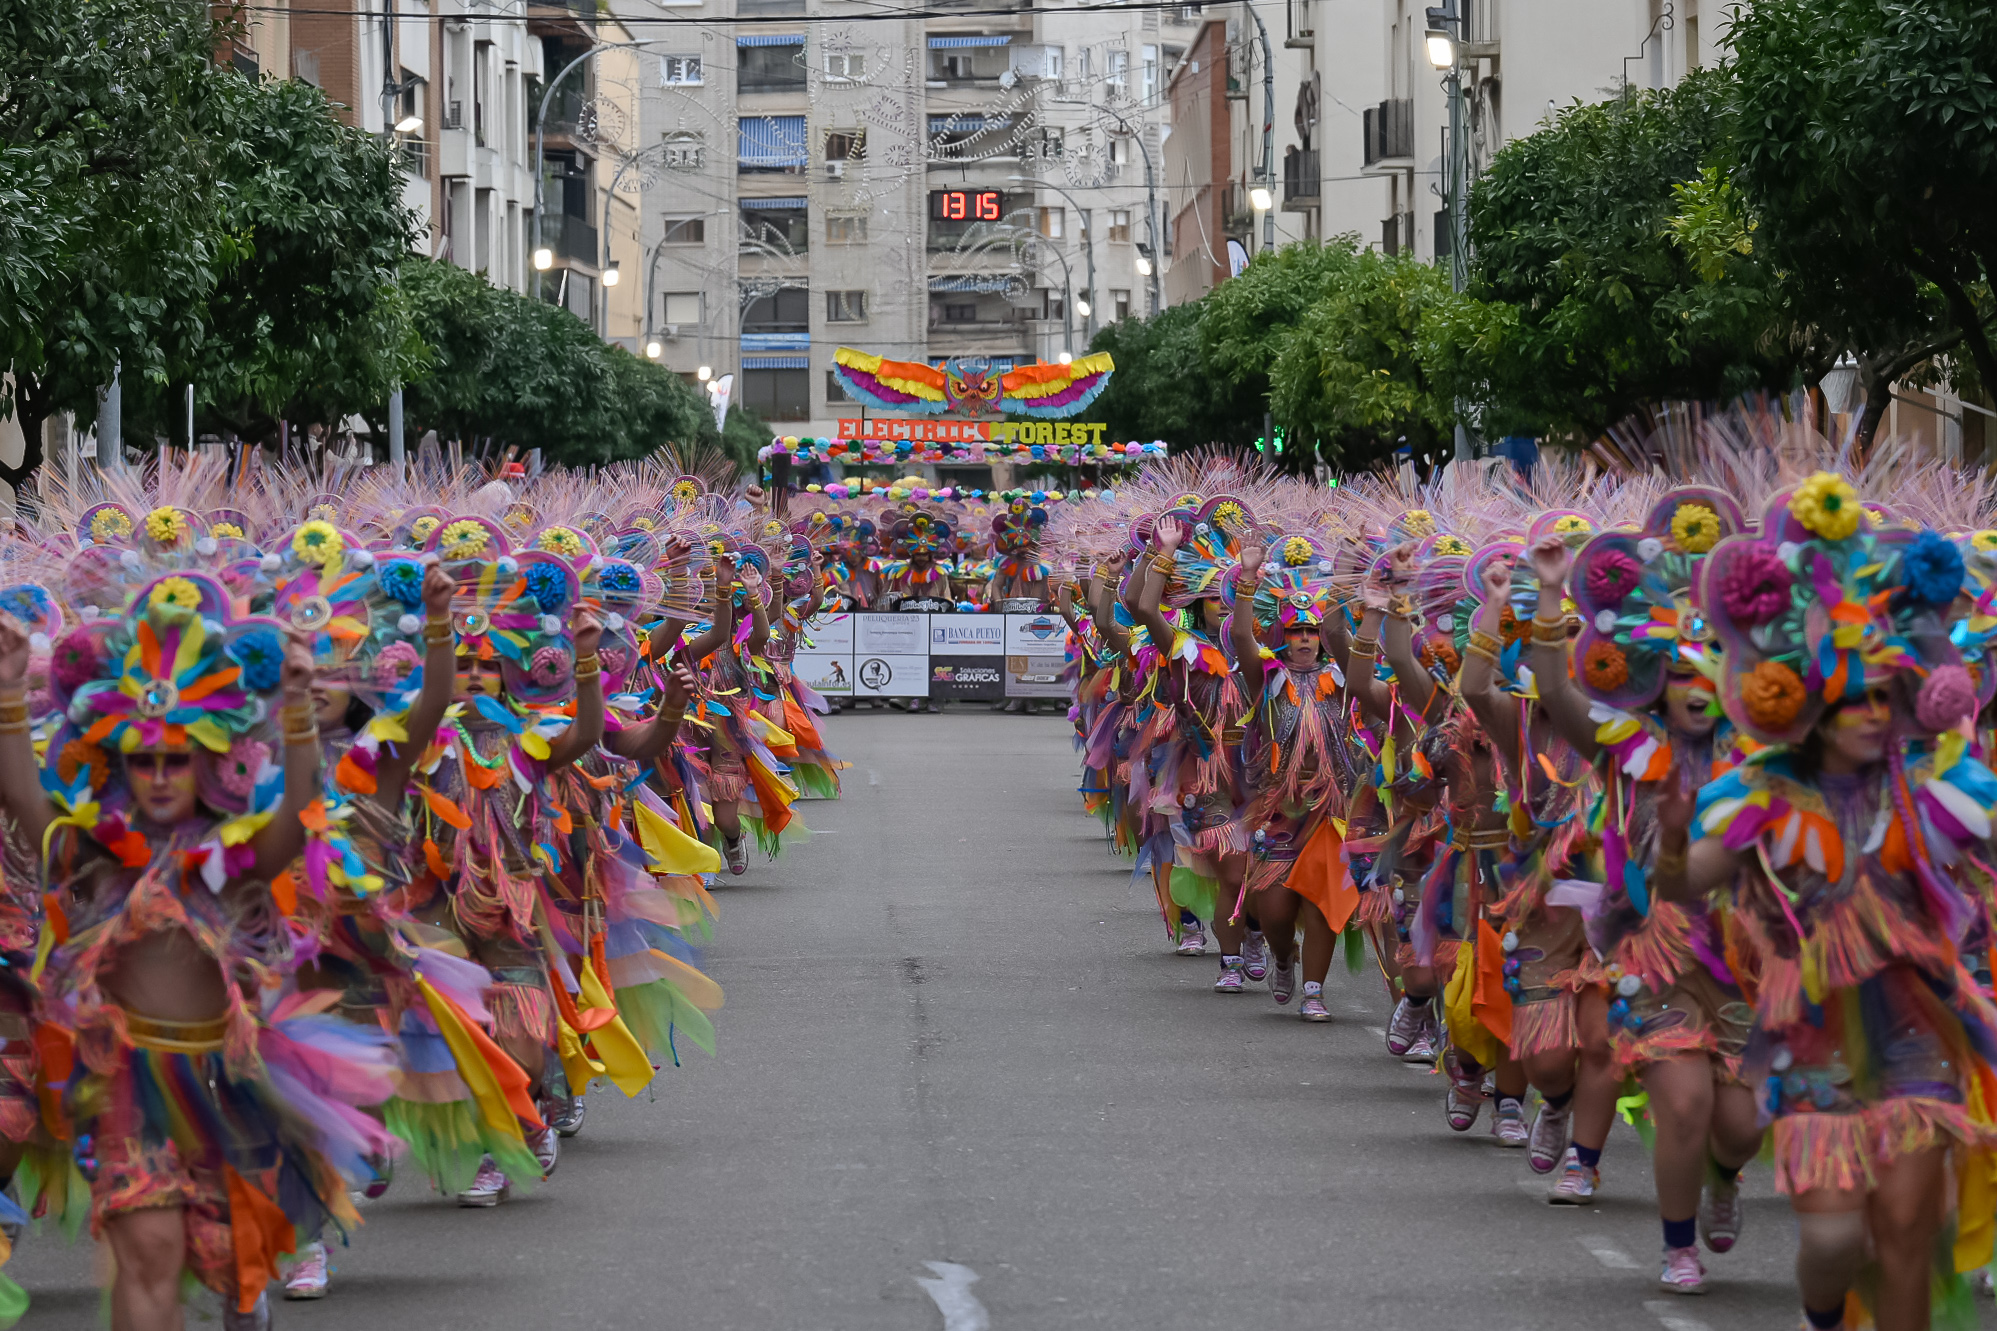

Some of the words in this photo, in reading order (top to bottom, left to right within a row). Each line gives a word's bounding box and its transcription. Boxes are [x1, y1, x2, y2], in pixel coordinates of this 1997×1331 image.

[943, 192, 966, 220] 13
[976, 192, 999, 220] 15
[837, 418, 975, 442] ELECTRIC
[1003, 421, 1107, 445] FOREST
[948, 627, 973, 639] BANCA
[976, 627, 1001, 639] PUEYO
